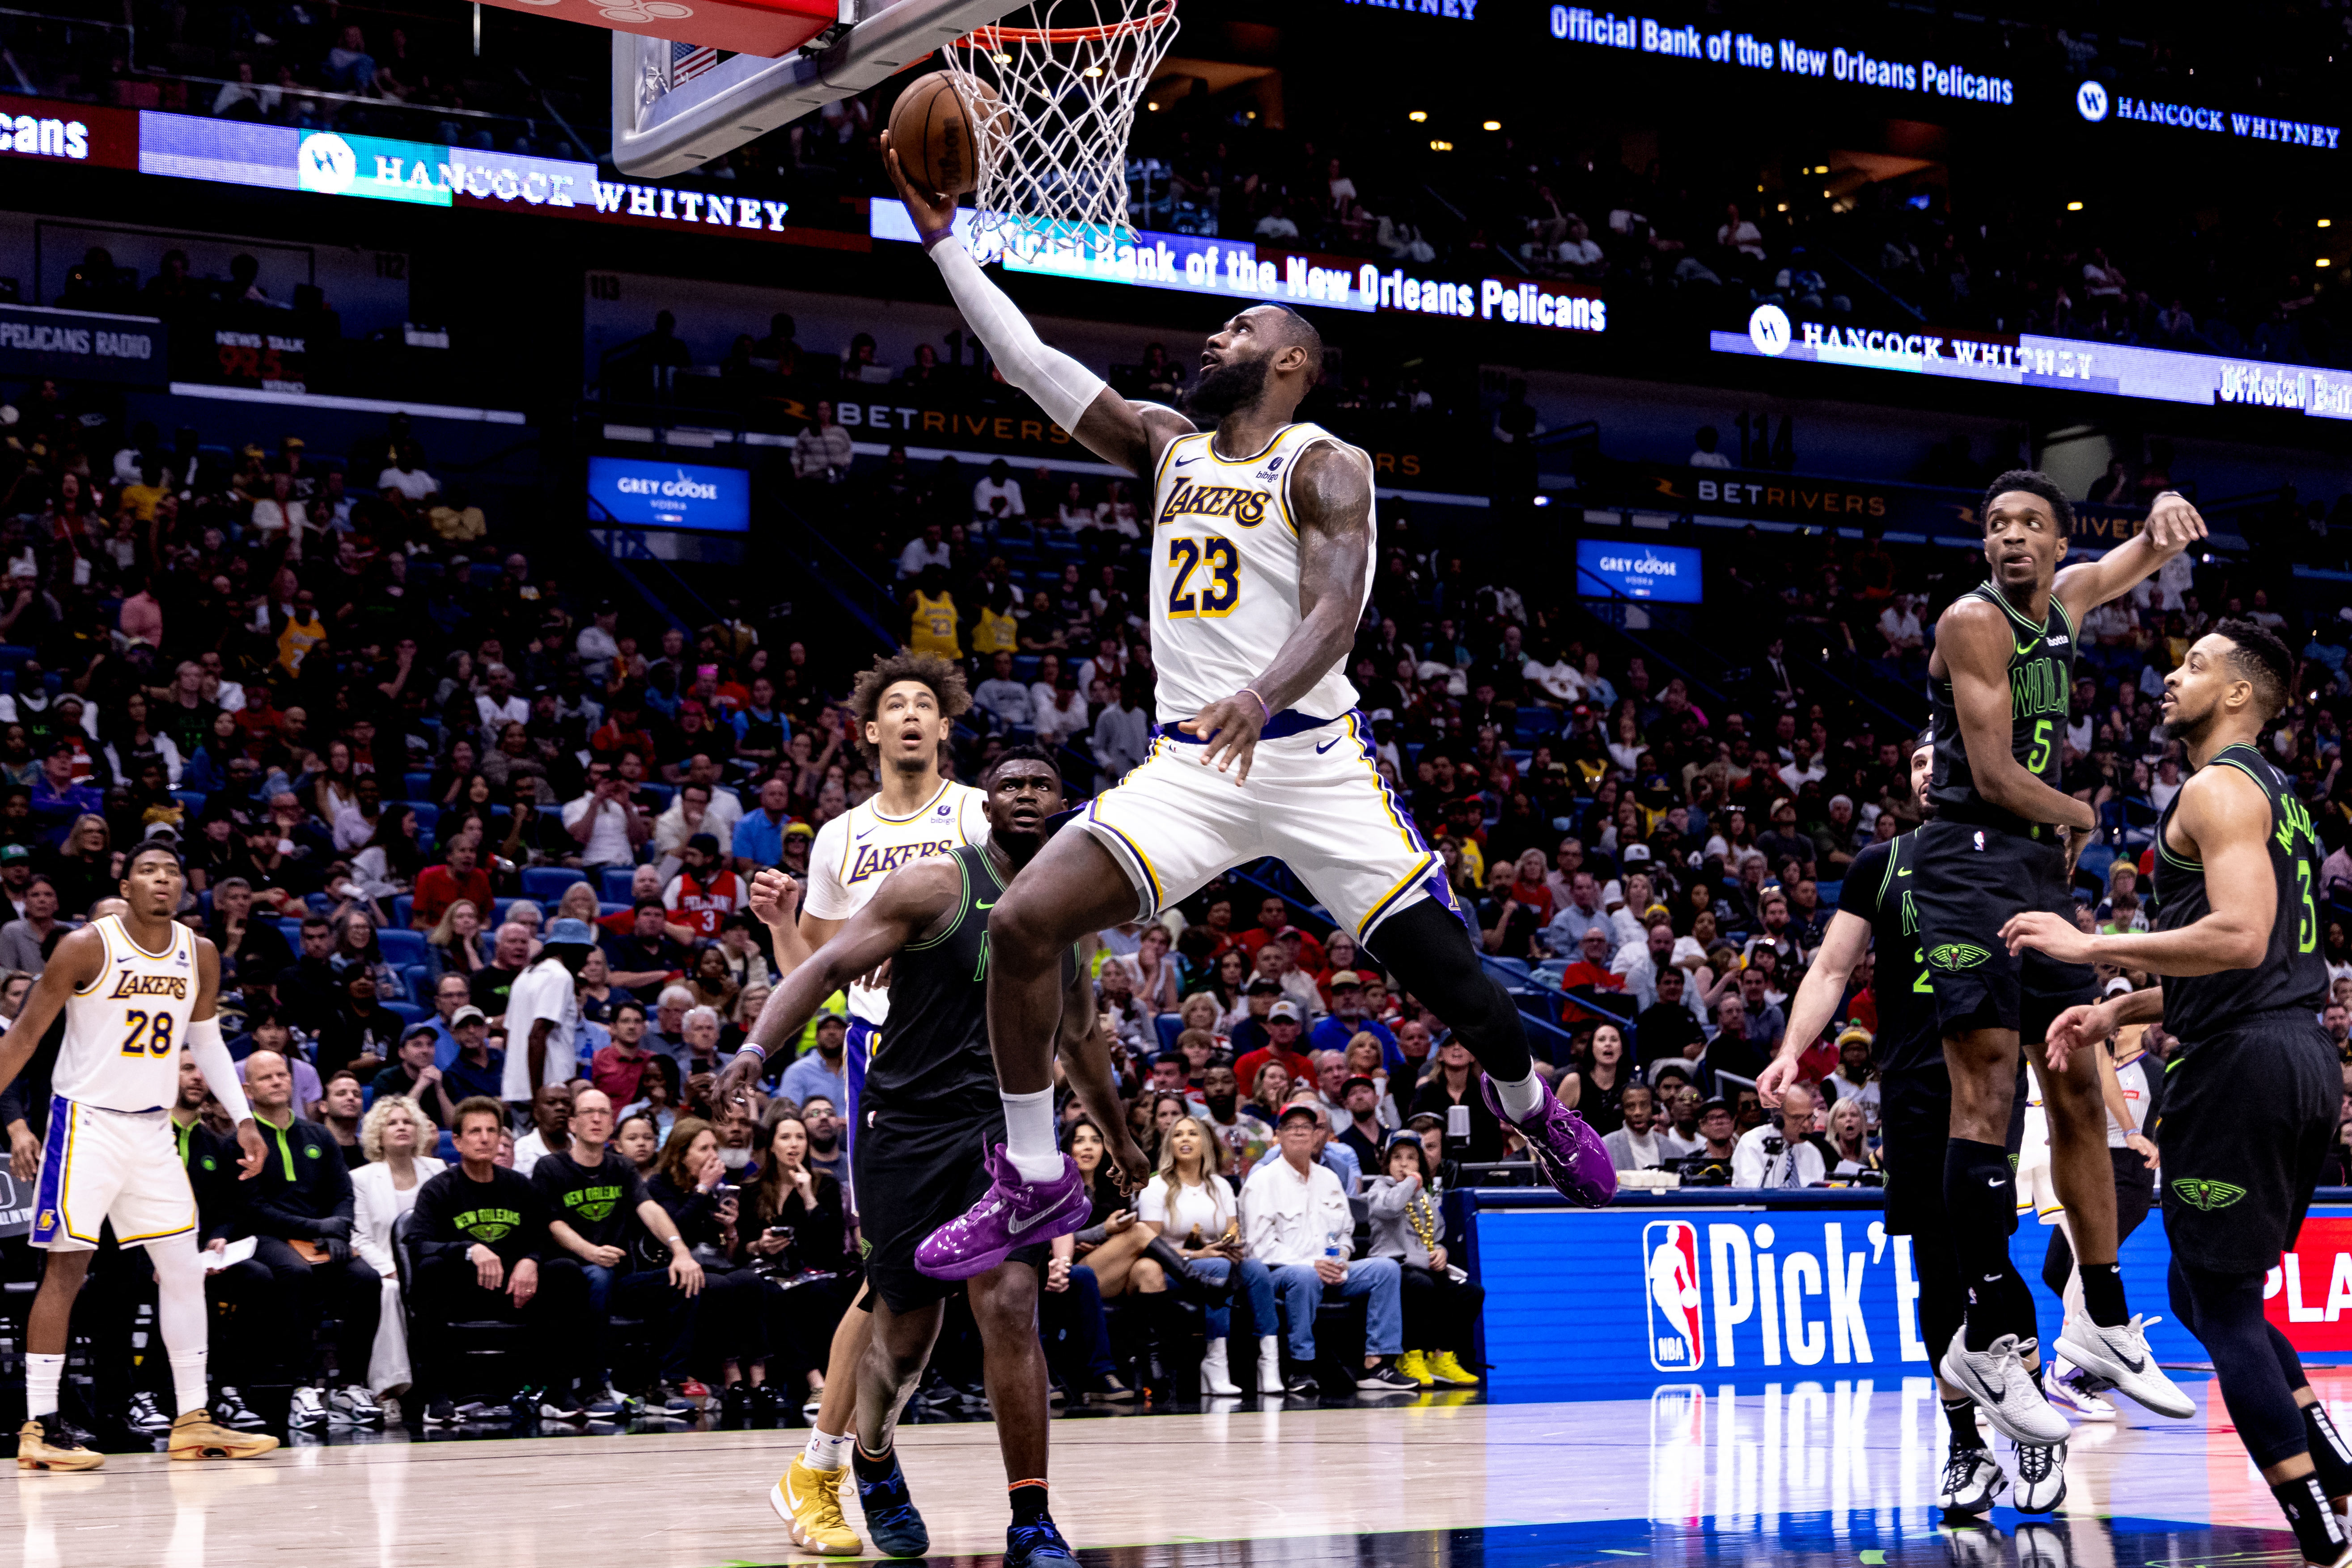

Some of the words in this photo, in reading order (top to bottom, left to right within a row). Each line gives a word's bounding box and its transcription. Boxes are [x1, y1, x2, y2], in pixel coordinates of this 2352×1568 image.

[1551, 5, 1637, 49] Official
[1642, 19, 1702, 59] Bank
[1706, 30, 1731, 63] of
[1736, 34, 1774, 69] the
[1779, 39, 1827, 77] New
[1833, 47, 1916, 90] Orleans
[1922, 61, 2013, 105] Pelicans
[2117, 97, 2225, 132] HANCOCK
[2231, 112, 2340, 149] WHITNEY
[373, 154, 575, 208] HANCOCK
[591, 180, 788, 232] WHITNEY
[1095, 233, 1178, 283] Bank
[1185, 246, 1219, 288] of
[1226, 250, 1278, 295] the
[1286, 256, 1352, 303] New
[1359, 264, 1475, 318] Orleans
[1481, 279, 1606, 332] Pelicans
[1802, 322, 1943, 364] HANCOCK
[617, 476, 660, 495] GREY
[661, 480, 718, 500] GOOSE
[1158, 476, 1273, 529] LAKERS
[1255, 470, 1279, 483] bibigo
[1168, 537, 1241, 620] 23
[2027, 719, 2053, 774] 5
[930, 816, 956, 825] bibigo
[701, 910, 715, 932] 3
[2297, 858, 2317, 954] 3
[107, 970, 188, 1000] LAKERS
[121, 1009, 174, 1059] 28
[1708, 1220, 1930, 1368] Pick'E
[1657, 1337, 1685, 1361] NBA
